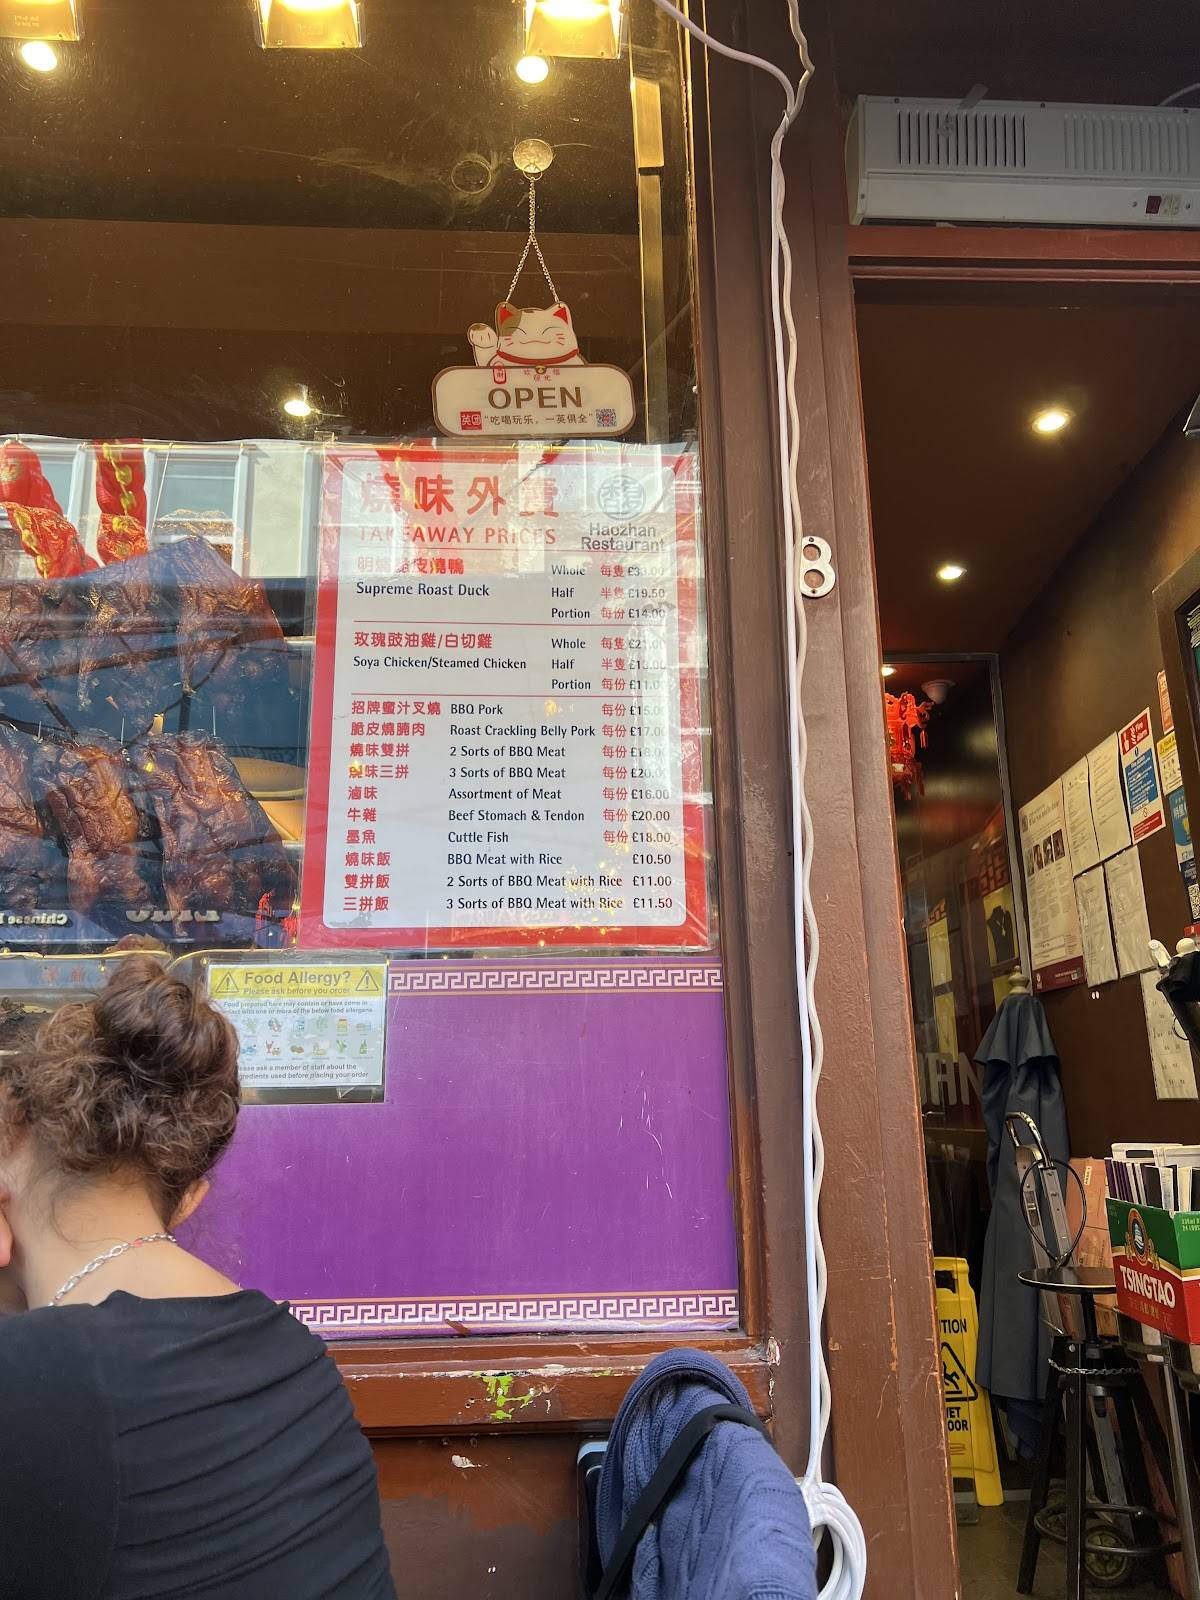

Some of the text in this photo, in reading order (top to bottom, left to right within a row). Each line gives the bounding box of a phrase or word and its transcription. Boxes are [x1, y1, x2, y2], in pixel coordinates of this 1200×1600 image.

[488, 386, 582, 410] OPEN
[485, 527, 557, 545] PRICES
[589, 522, 656, 537] Haozhan
[581, 536, 664, 551] Restaurant
[551, 564, 586, 576] Whole
[800, 535, 836, 598] 8
[356, 581, 490, 598] Supreme Roast Duck
[551, 587, 575, 598] Half
[628, 588, 665, 598] £19.50
[551, 607, 590, 618] Portion
[628, 608, 666, 618] £14.00
[551, 638, 586, 649] Whole
[353, 656, 527, 670] Soya Chicken/Steamed Chicken
[551, 659, 575, 669] Half
[551, 679, 591, 690] Portion
[601, 678, 625, 691] 每份
[450, 704, 475, 715] BBQ
[478, 704, 504, 715] Pork
[602, 704, 626, 716] 每份
[450, 725, 481, 736] Roast
[485, 725, 537, 738] Crackling
[541, 725, 567, 738] Belly
[571, 725, 596, 737] Pork
[602, 724, 627, 738] 每份
[449, 746, 457, 757] 2
[460, 745, 490, 757] Sorts
[493, 745, 506, 757] of
[509, 746, 533, 757] BBQ
[537, 746, 566, 757] Meat
[602, 745, 627, 758] 每份
[449, 767, 456, 778] 3
[460, 766, 490, 778] Sorts
[493, 766, 506, 778] of
[509, 767, 533, 778] BBQ
[537, 767, 566, 778] Meat
[602, 766, 628, 779] 每份
[448, 788, 512, 800] Assortment
[516, 788, 529, 799] of
[532, 788, 562, 799] Meat
[602, 787, 628, 800] 每份
[631, 789, 670, 800] £16.00
[448, 810, 474, 821] Beef
[478, 809, 527, 821] Stomach
[531, 810, 541, 821] &
[544, 809, 585, 821] Tendon
[632, 810, 670, 821] £20.00
[448, 831, 483, 843] Cuttle
[487, 831, 509, 842] Fish
[632, 832, 671, 843] £18.00
[345, 851, 672, 867] 燒味飯 BBQ Meat with Rice £10.50
[344, 873, 672, 889] 雙拼飯 2 Sorts of BBQ Meat with Rice £11.00
[343, 896, 672, 911] 三拼飯 3 Sorts of BBQ Meat with Rice £11.50
[244, 970, 351, 986] Food Allergy?
[243, 987, 270, 995] Please
[271, 987, 286, 995] ask
[1119, 1265, 1176, 1309] TSINGTAO
[939, 1318, 968, 1334] TION
[947, 1419, 969, 1432] OOR
